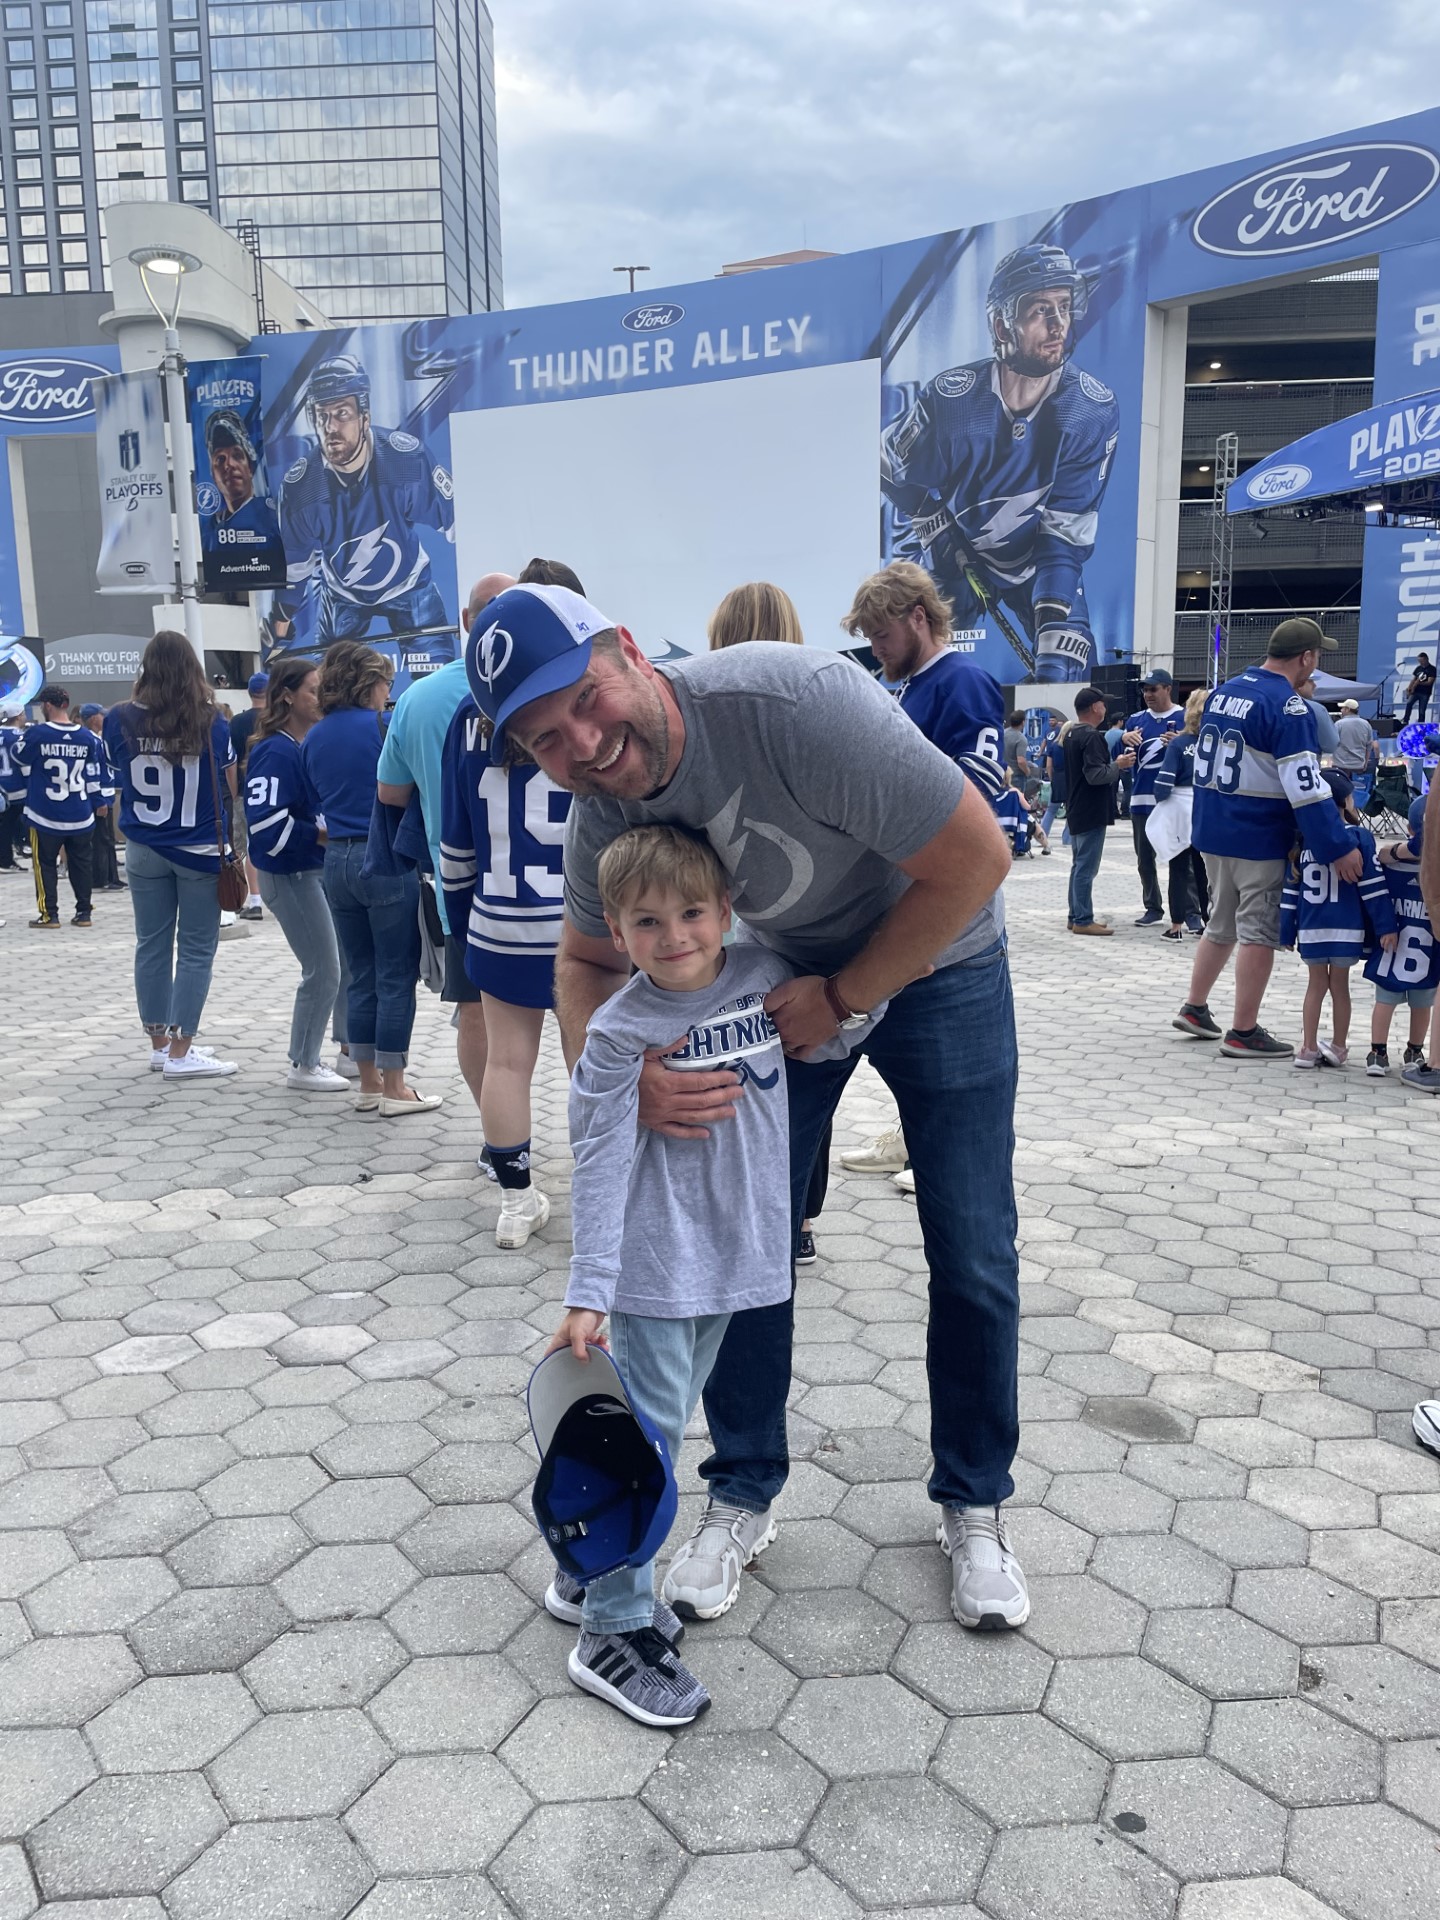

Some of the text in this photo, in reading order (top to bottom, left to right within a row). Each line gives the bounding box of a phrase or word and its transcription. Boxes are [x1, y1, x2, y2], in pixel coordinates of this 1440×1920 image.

[1238, 161, 1390, 245] Ford
[634, 306, 673, 329] Ford
[508, 315, 811, 391] THUNDER ALLEY
[0, 368, 89, 411] Ford
[213, 397, 241, 407] 2023
[106, 483, 163, 500] PLAYOFFS
[111, 474, 158, 486] STANLEY CUP
[1259, 470, 1297, 496] Ford
[218, 529, 236, 544] 88
[59, 651, 140, 663] THANK YOU FOR
[60, 664, 93, 676] BEING
[94, 664, 115, 675] THE
[409, 654, 428, 662] ERIK
[1209, 694, 1254, 720] GILMOUR
[40, 743, 89, 758] MATTHEWS
[1195, 723, 1245, 794] 93
[43, 758, 88, 801] 34
[129, 754, 200, 827] 91
[247, 776, 279, 807] 31
[1303, 863, 1339, 904] 91
